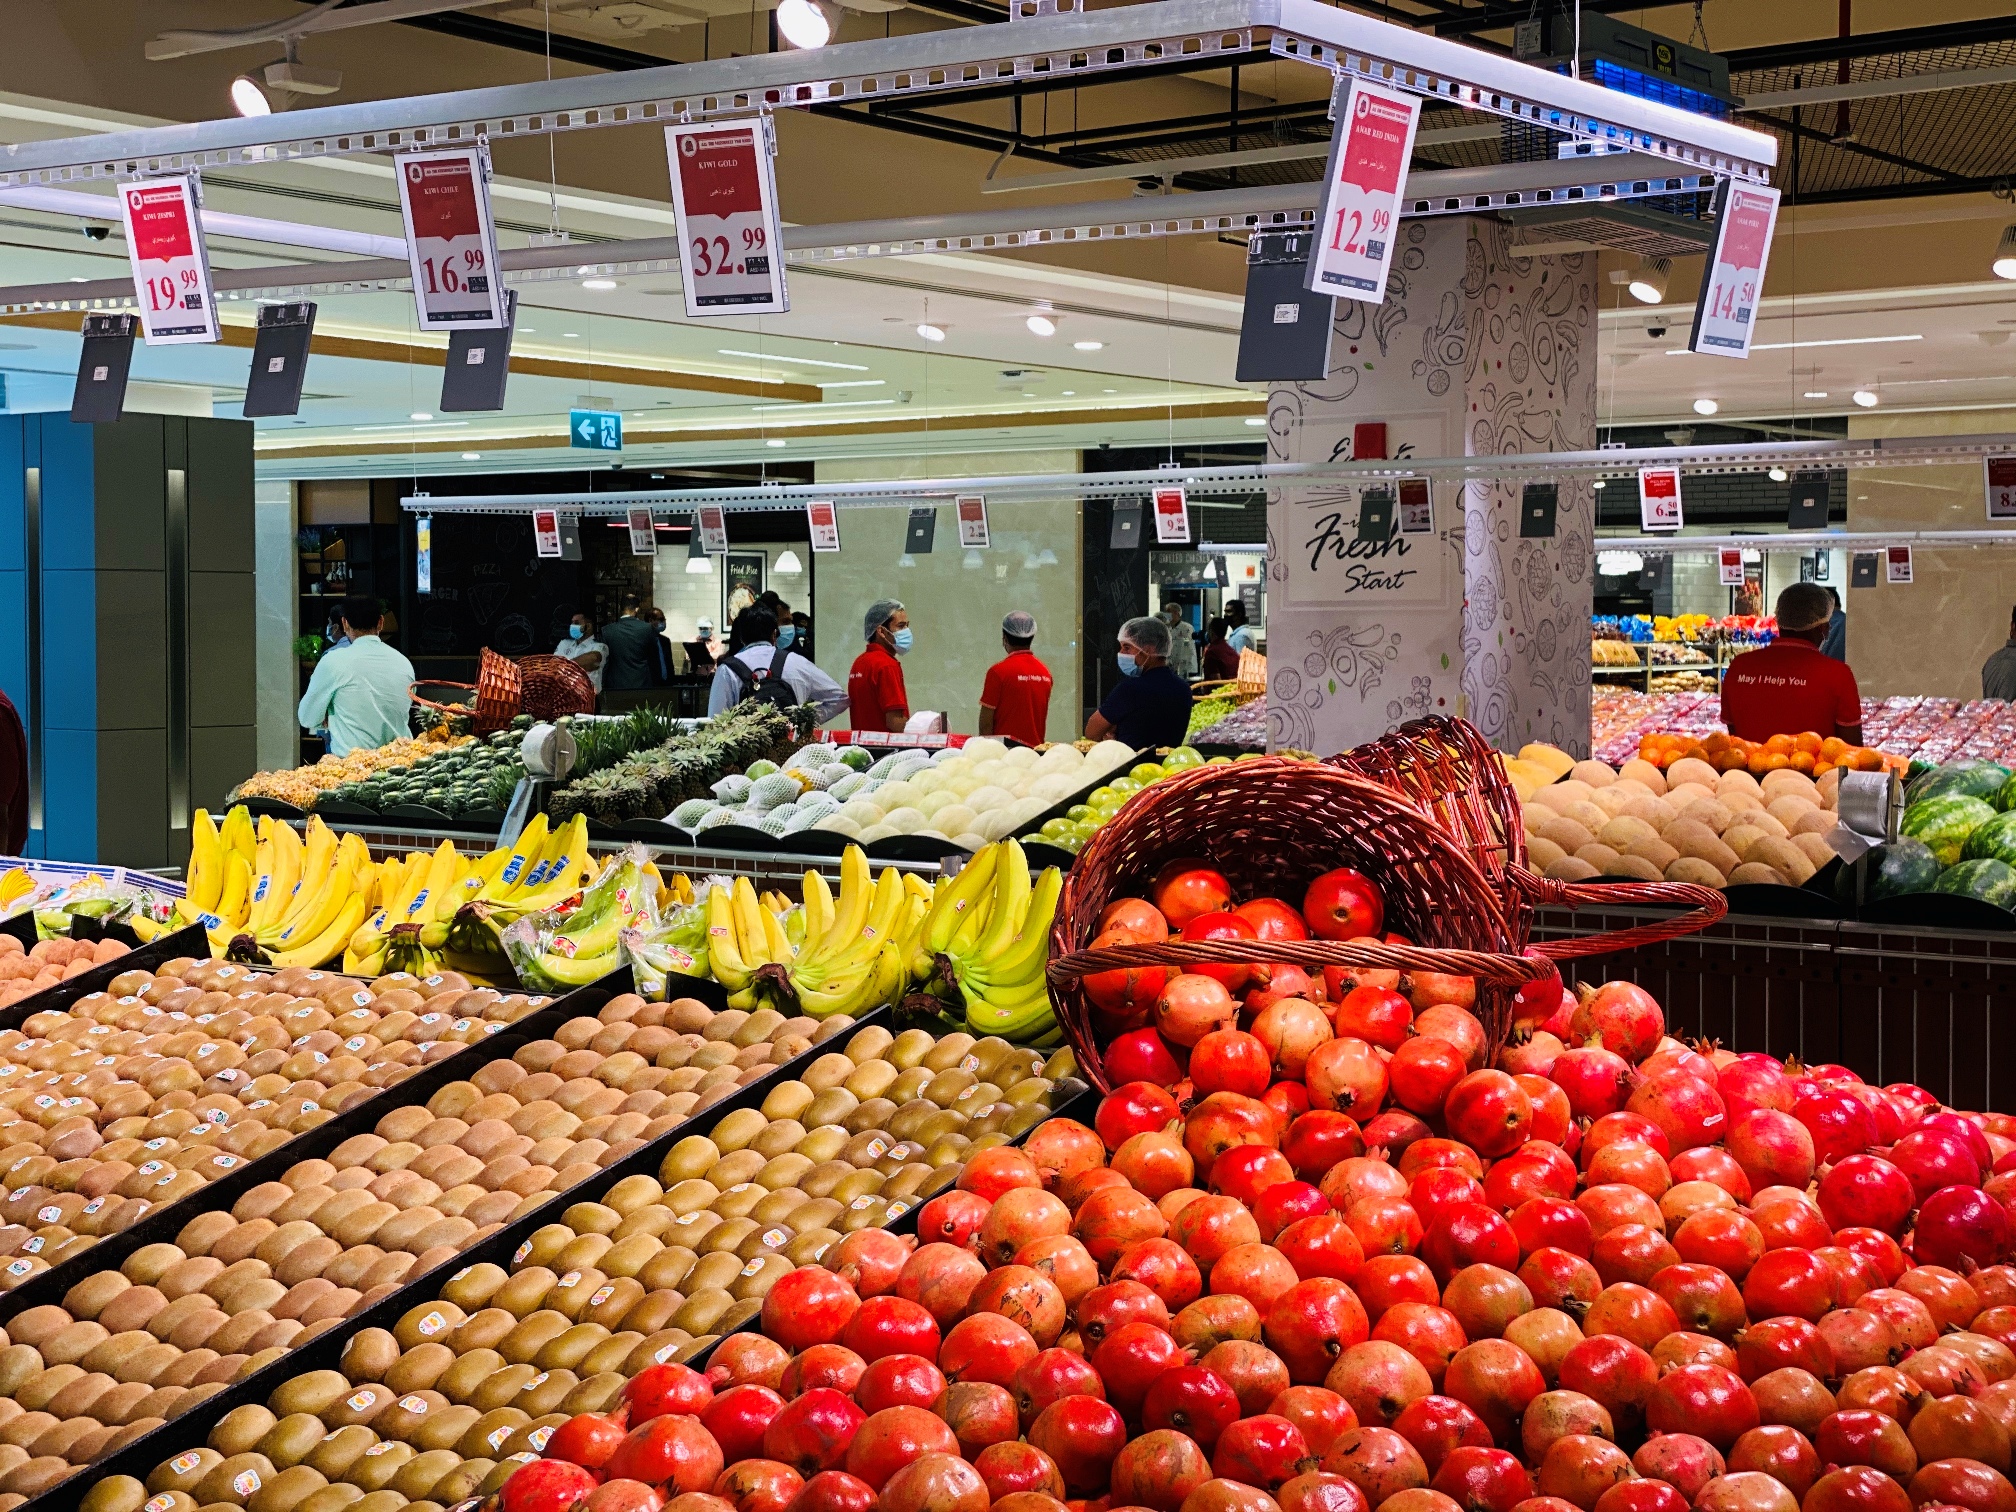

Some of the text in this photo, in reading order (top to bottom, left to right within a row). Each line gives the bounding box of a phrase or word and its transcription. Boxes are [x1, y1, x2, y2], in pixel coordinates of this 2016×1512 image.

[1372, 129, 1384, 139] RED
[698, 159, 738, 169] KIWI GOLD
[424, 186, 460, 195] KIWI CHILE
[142, 213, 157, 221] KIWI
[1344, 563, 1418, 594] Start
[1738, 674, 1757, 685] May
[1764, 675, 1786, 687] Help
[1788, 677, 1807, 687] You
